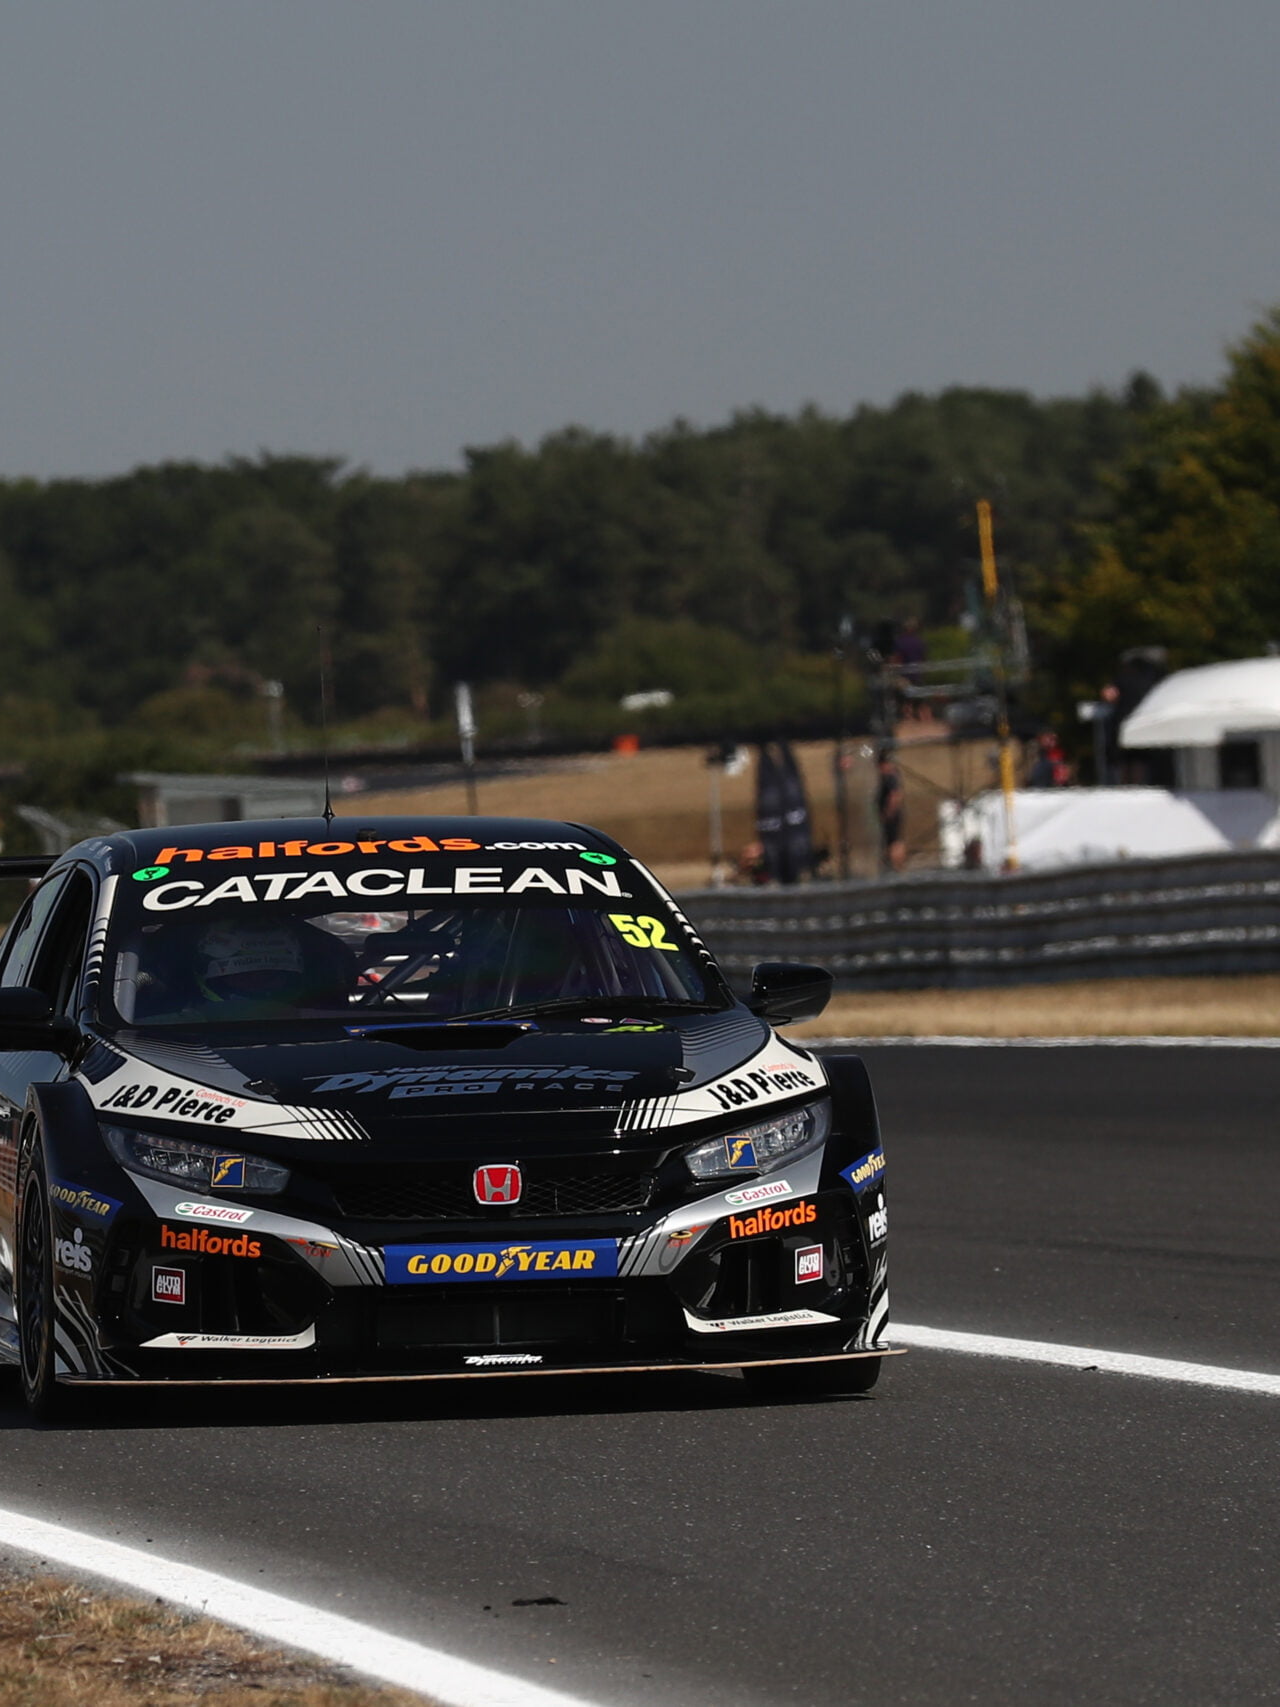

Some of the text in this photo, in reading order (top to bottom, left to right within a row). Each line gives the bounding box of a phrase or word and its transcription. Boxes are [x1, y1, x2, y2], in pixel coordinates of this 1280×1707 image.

[154, 836, 587, 865] halfords.com
[142, 867, 622, 911] CATACLEAN
[607, 914, 680, 951] 52
[304, 1065, 641, 1094] Dynamics
[405, 1082, 624, 1096] PRO RACE
[706, 1068, 817, 1110] J&D Pierce
[152, 1087, 236, 1124] Pierce
[742, 1182, 789, 1201] Castrol
[192, 1205, 246, 1222] Castrol
[729, 1201, 817, 1239] halfords
[56, 1228, 93, 1272] reis
[161, 1225, 262, 1259] halfords
[200, 1335, 298, 1344] Walker Logistics
